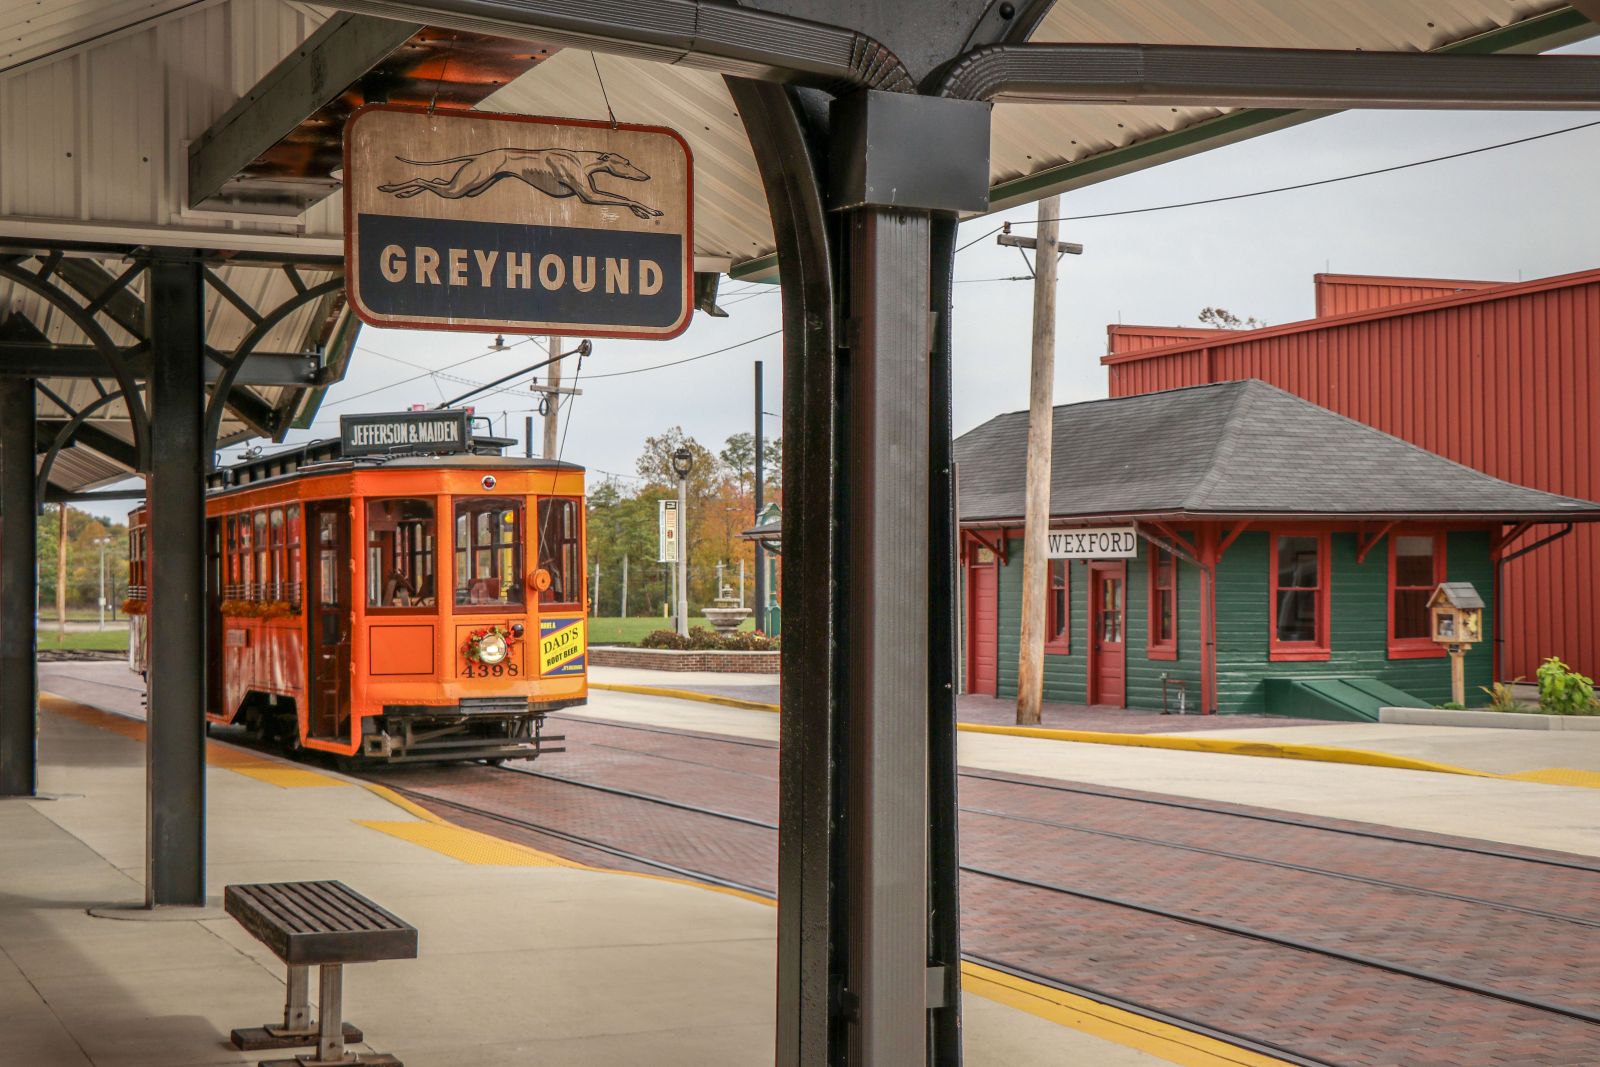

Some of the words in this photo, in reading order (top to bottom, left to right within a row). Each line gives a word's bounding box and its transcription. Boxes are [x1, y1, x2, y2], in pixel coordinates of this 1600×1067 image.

[379, 244, 664, 296] GREYHOUND
[351, 423, 407, 445] JEFFERSON
[418, 421, 458, 442] MAIDEN
[1048, 532, 1135, 553] WEXFORD
[544, 627, 579, 654] DAD'S
[547, 654, 562, 666] ROOT
[563, 646, 578, 659] BEER
[462, 663, 518, 678] 4398
